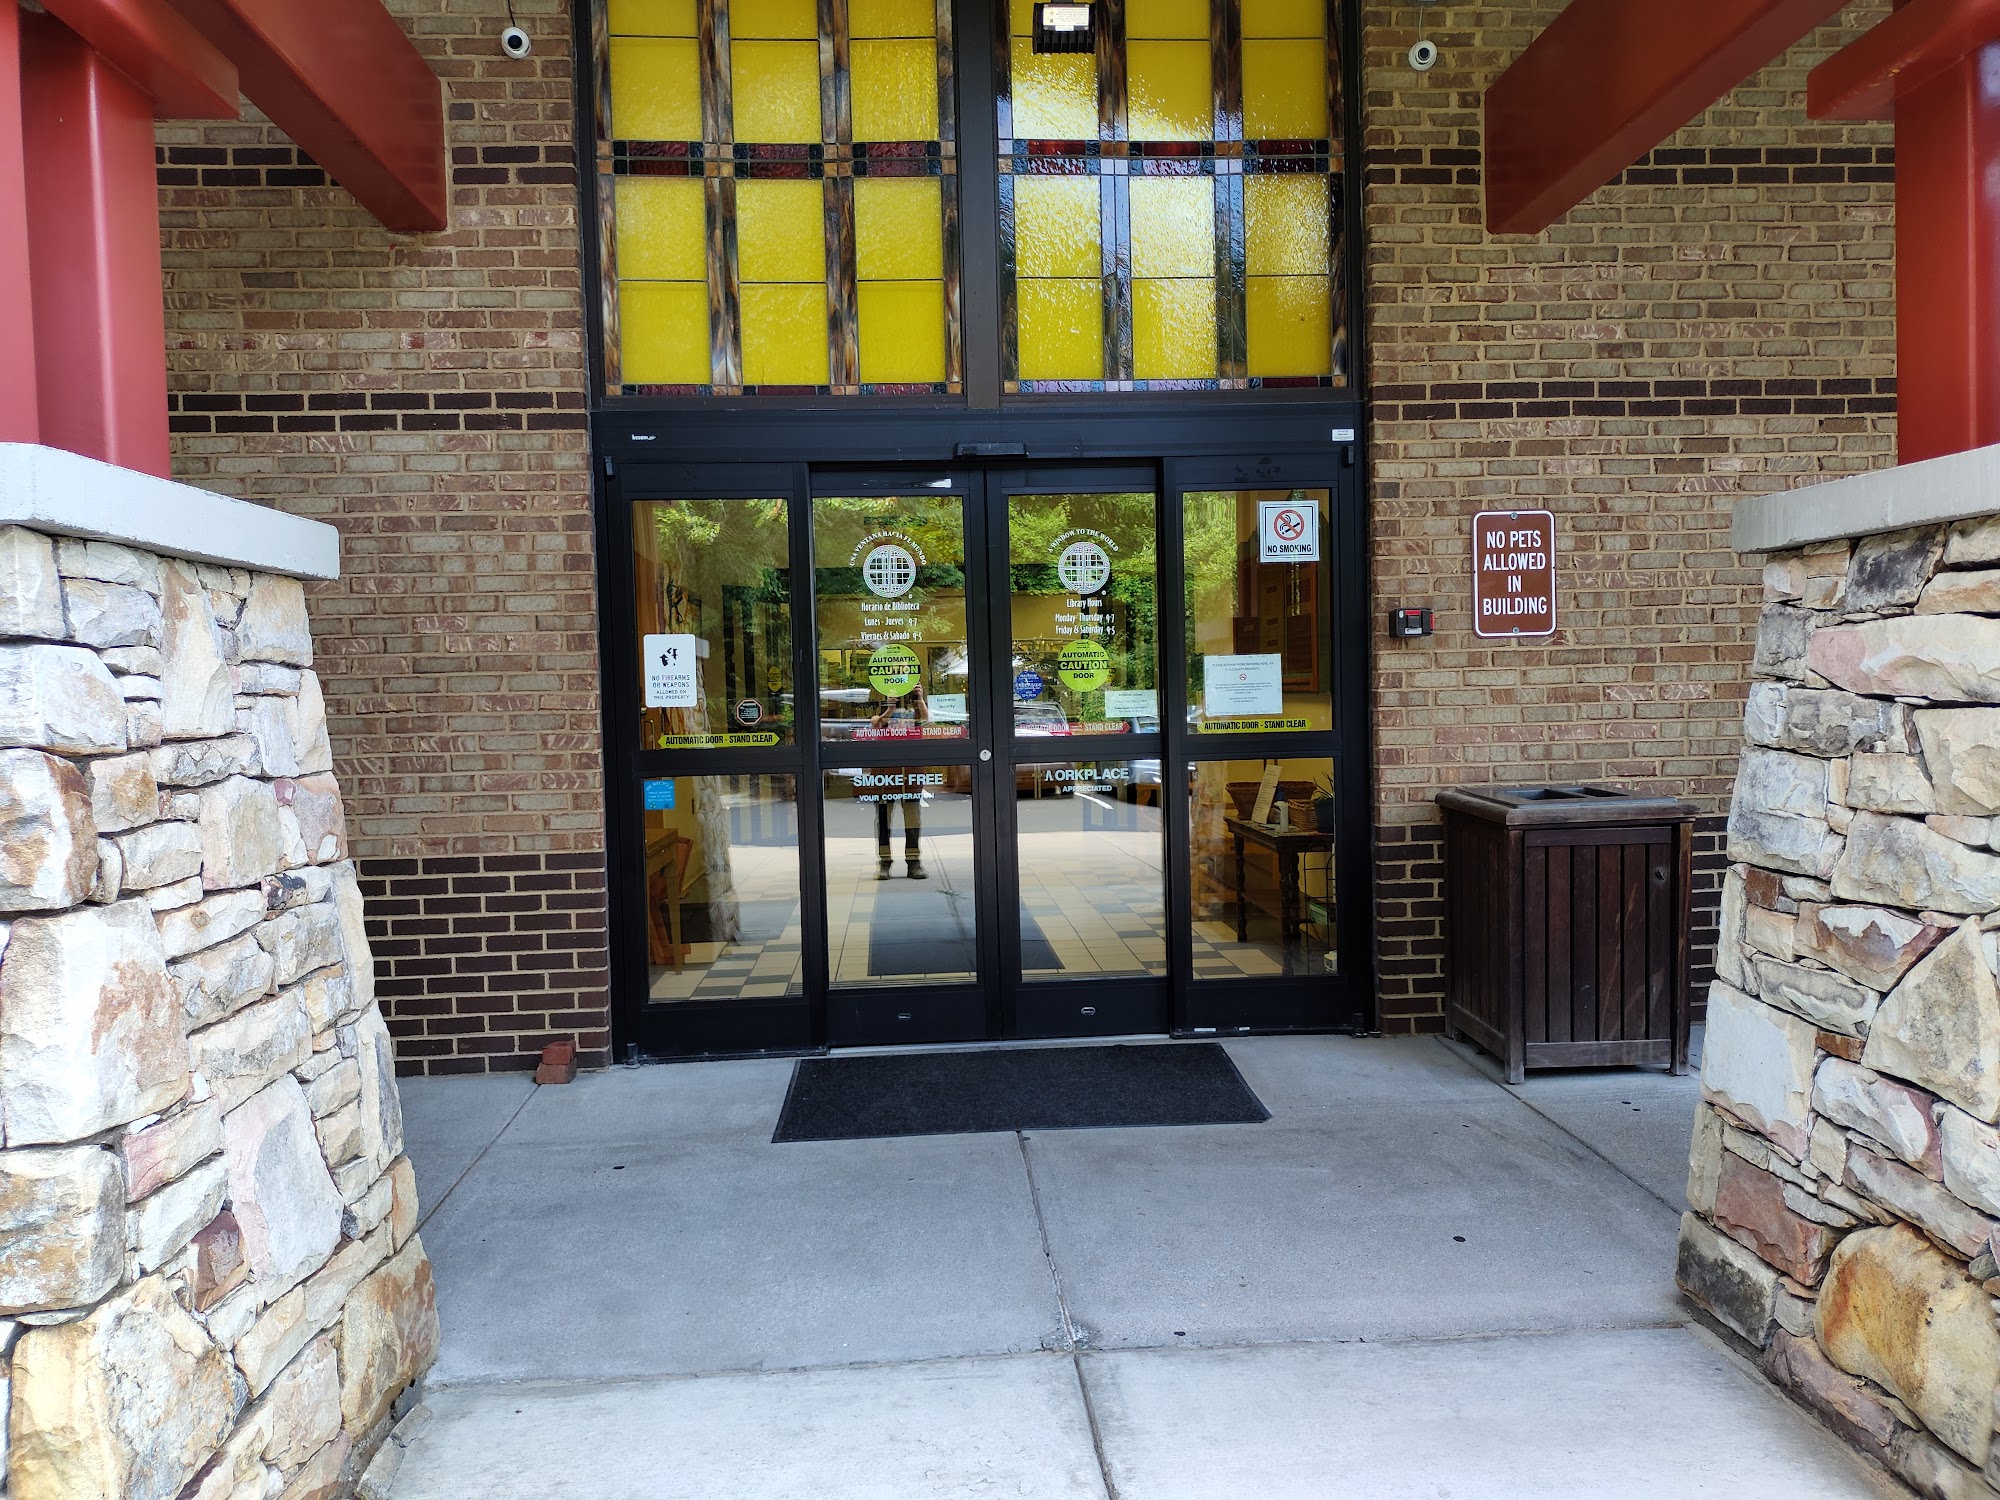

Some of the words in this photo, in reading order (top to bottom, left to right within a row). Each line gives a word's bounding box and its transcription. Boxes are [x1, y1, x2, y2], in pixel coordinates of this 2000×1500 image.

[1050, 530, 1075, 549] WINDOW
[1100, 533, 1119, 552] WORLD
[1486, 531, 1505, 548] NO
[1510, 530, 1541, 548] PETS
[850, 553, 858, 566] UNA
[855, 532, 882, 552] VENTANA
[882, 531, 903, 539] HACIA
[910, 541, 926, 565] MUNDO
[1268, 545, 1278, 553] NO
[1280, 544, 1311, 552] SMOKING
[1483, 552, 1546, 570] ALLOWED
[1508, 575, 1522, 592] IN
[861, 602, 882, 611] Horario
[884, 602, 891, 611] de
[892, 602, 920, 611] Biblioteca
[1066, 598, 1086, 609] Library
[1087, 598, 1102, 607] Hours
[1483, 597, 1547, 615] BUILDING
[864, 617, 880, 626] Lunes
[885, 617, 904, 625] Jueves
[908, 618, 917, 626] 9-7
[1078, 613, 1103, 623] Thursday
[1105, 613, 1115, 623] 9-7
[1056, 625, 1073, 636] Friday
[1074, 625, 1079, 634] &
[1080, 625, 1103, 635] Saturday
[1106, 626, 1115, 635] 9-5
[861, 632, 882, 640] Viernes
[883, 631, 889, 640] &
[912, 632, 922, 641] 9-5
[871, 666, 918, 674] CAUTION
[1060, 661, 1108, 670] CAUTION
[1085, 723, 1104, 731] STAND
[1205, 722, 1241, 730] AUTOMATIC
[856, 728, 890, 737] AUTOMATIC
[891, 728, 907, 736] DOOR
[922, 727, 941, 736] STAND
[942, 727, 961, 735] CLEAR
[666, 735, 704, 745] AUTOMATIC
[705, 734, 724, 744] DOOR
[730, 734, 750, 743] STAND
[752, 734, 773, 743] CLEAR
[853, 774, 904, 786] SMOKE
[908, 774, 943, 785] FREE
